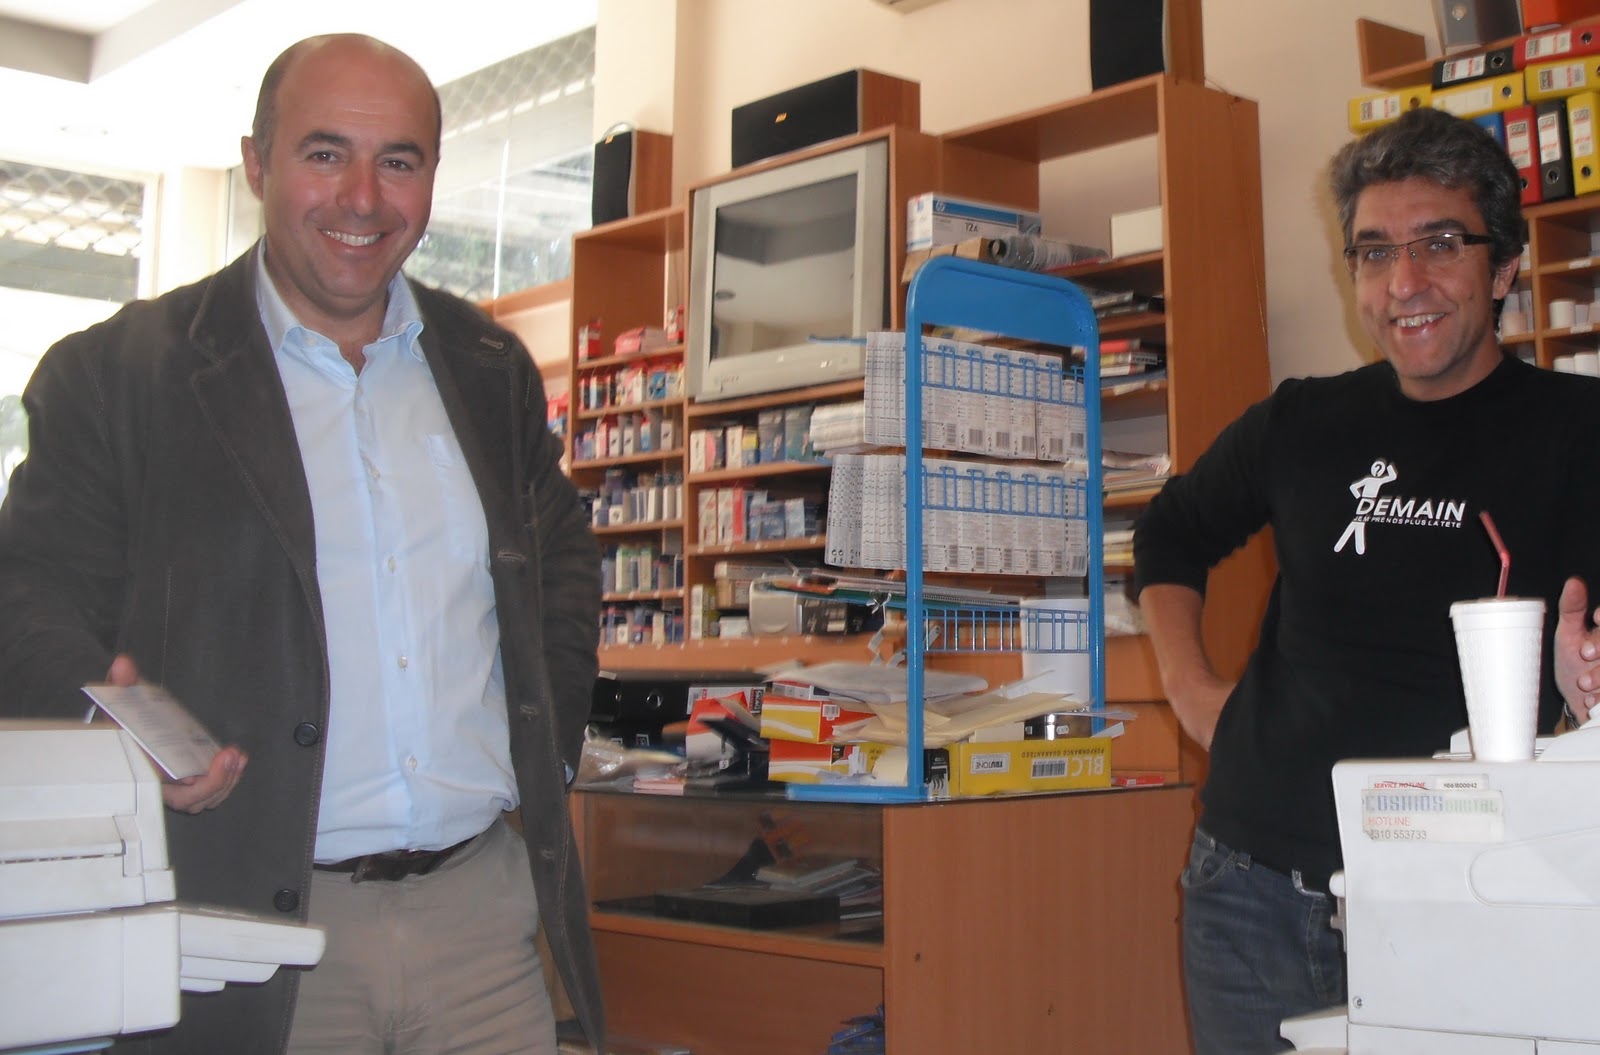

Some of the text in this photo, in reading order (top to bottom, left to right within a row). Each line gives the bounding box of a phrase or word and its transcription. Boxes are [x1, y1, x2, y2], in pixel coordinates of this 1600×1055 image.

[1355, 497, 1466, 522] DEMAIN
[975, 760, 1003, 770] TRUTONE
[1071, 755, 1104, 777] BLC
[1373, 781, 1398, 789] SERVICE
[1365, 795, 1444, 812] COSMOS
[1368, 816, 1411, 826] HOTLINE
[1393, 829, 1427, 840] 553733
